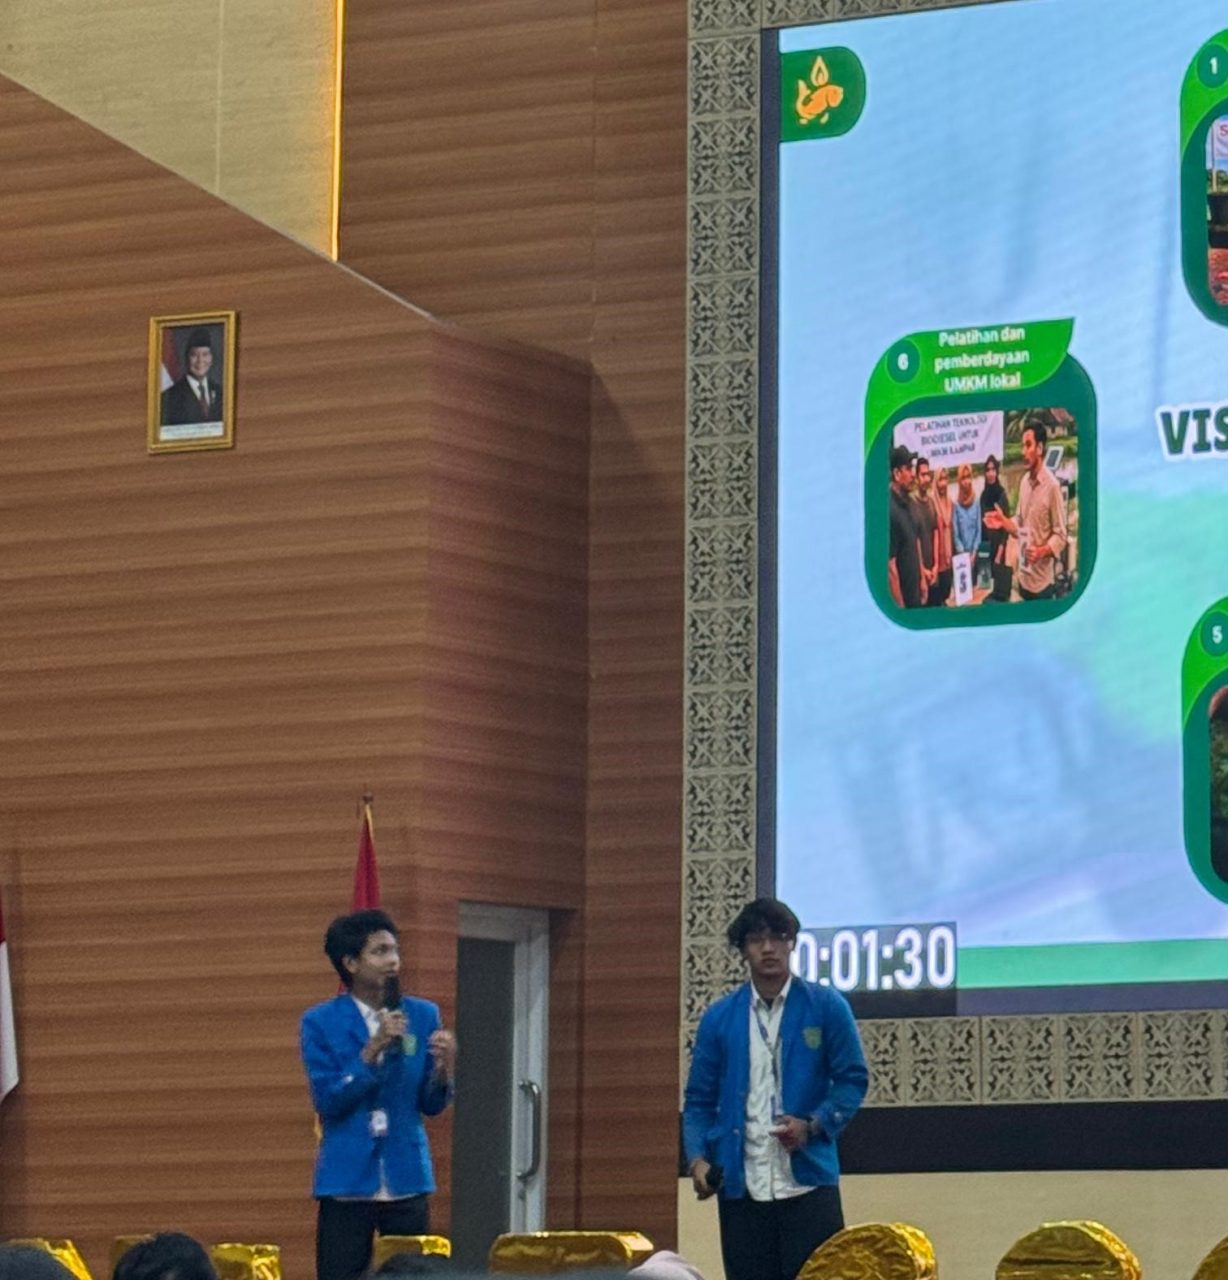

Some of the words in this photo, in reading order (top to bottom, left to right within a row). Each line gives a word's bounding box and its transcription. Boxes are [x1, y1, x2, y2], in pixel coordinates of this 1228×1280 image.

[1210, 57, 1217, 74] 1
[939, 330, 998, 347] Pelatihan
[1001, 326, 1025, 342] dan
[898, 353, 908, 370] 6
[934, 350, 1029, 374] pemberdayaan
[944, 375, 987, 393] UMKM
[990, 371, 1021, 390] lokal
[1212, 626, 1222, 644] 5
